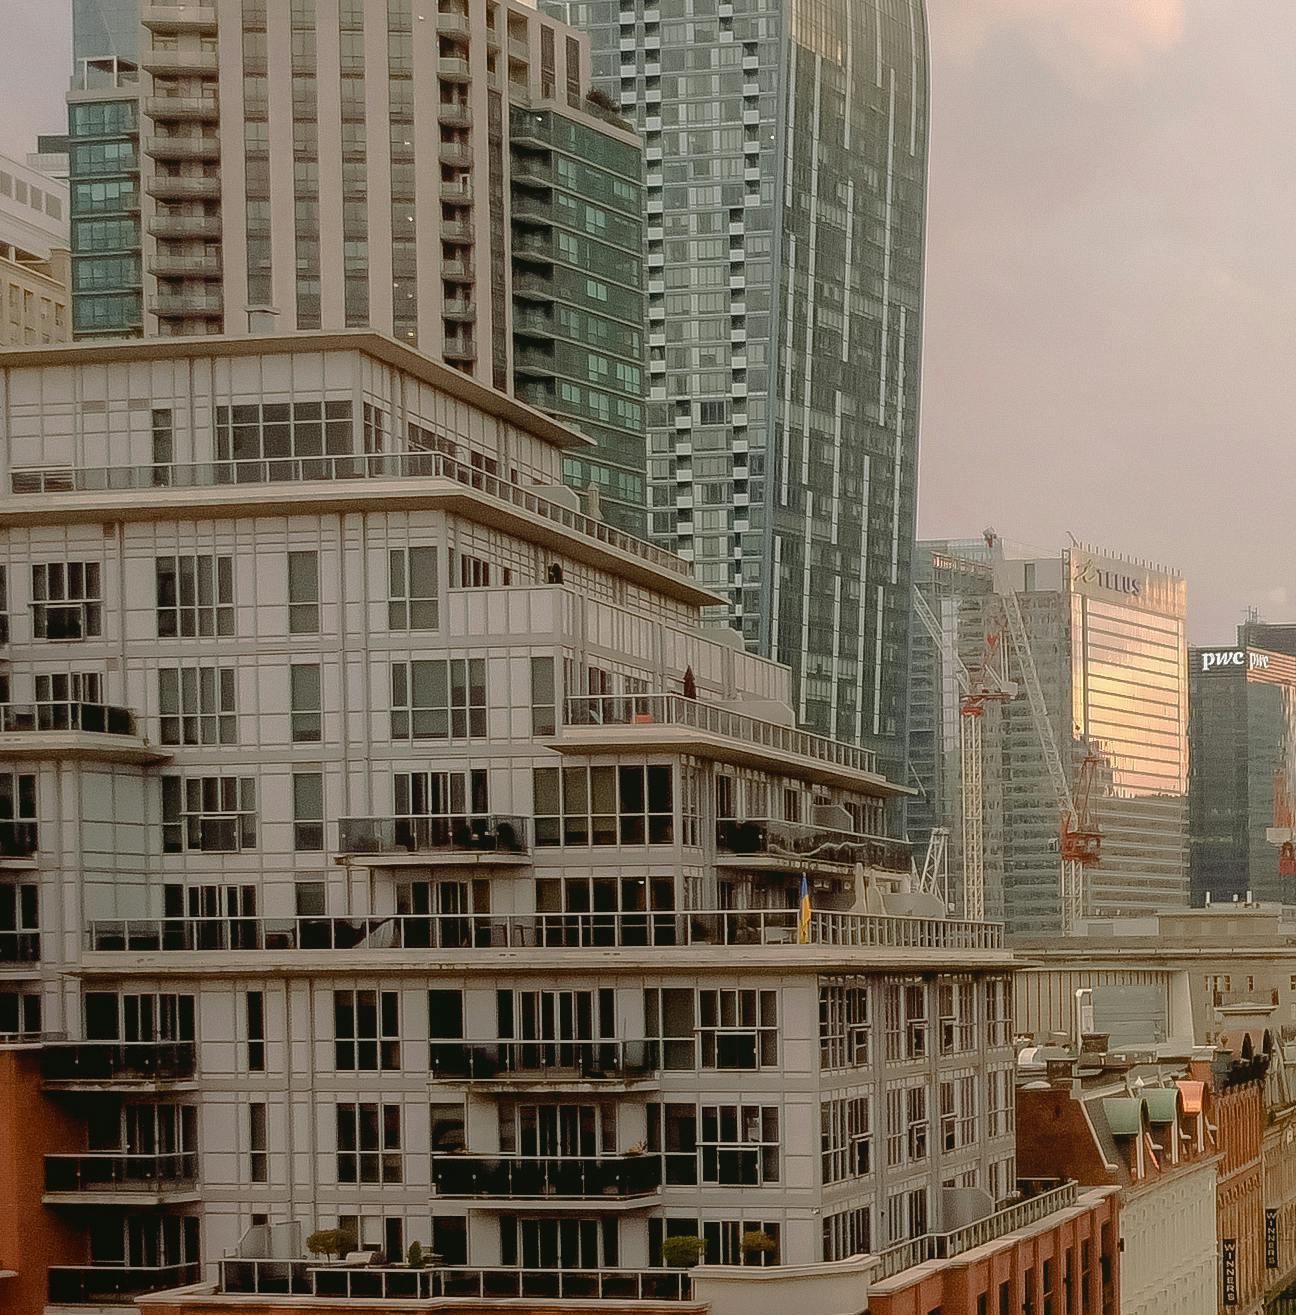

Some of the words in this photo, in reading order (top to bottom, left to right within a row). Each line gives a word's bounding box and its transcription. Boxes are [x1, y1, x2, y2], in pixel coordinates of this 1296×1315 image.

[1097, 569, 1141, 597] TELUS
[1201, 652, 1245, 672] pwc
[1249, 652, 1269, 671] pwc
[1266, 1212, 1277, 1265] WINNERS
[1224, 1243, 1236, 1301] WINNERS
